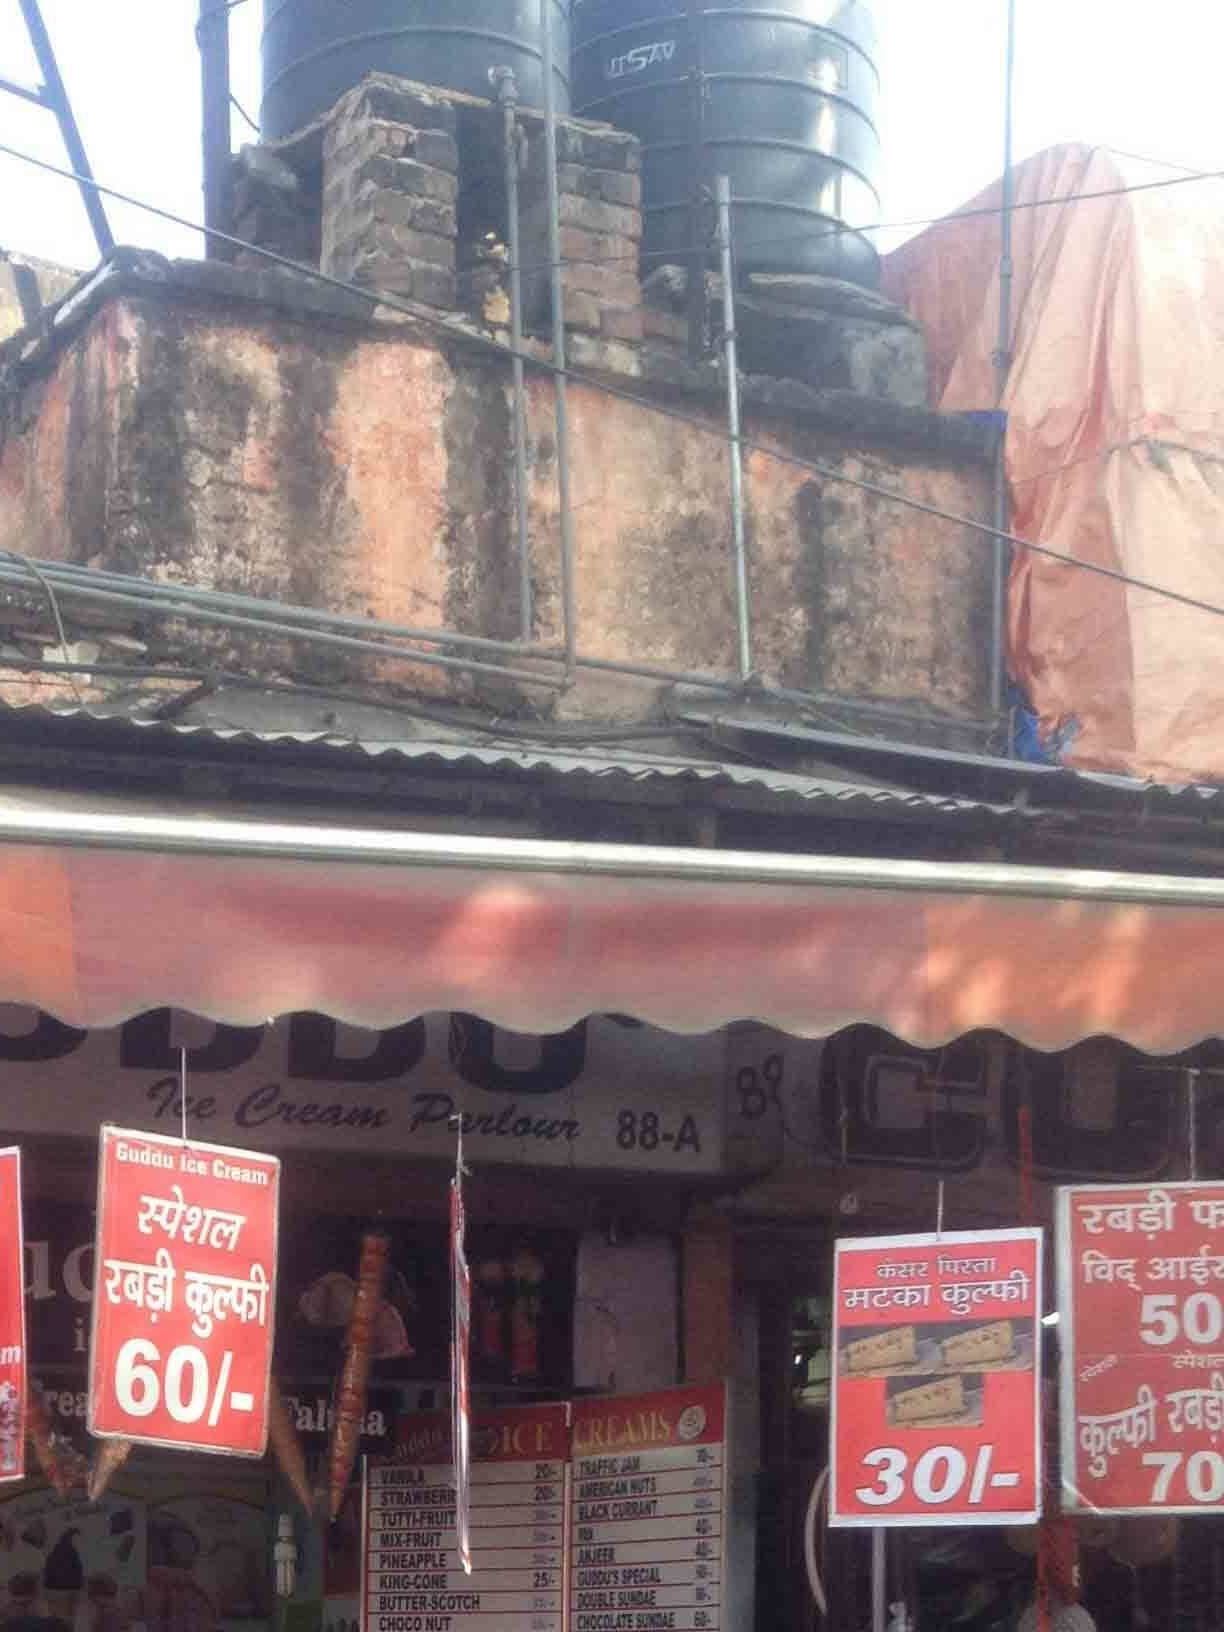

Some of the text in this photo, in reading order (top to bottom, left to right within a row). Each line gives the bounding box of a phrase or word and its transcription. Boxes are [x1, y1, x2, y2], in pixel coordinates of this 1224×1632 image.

[235, 1084, 390, 1129] Cream
[410, 1093, 580, 1143] Parlour
[615, 1108, 701, 1154] 88-A
[115, 1141, 268, 1186] Guddu Ice Cream
[137, 1185, 247, 1252] स्पेशल
[1077, 1190, 1176, 1240] रबड़ी
[104, 1247, 176, 1324] रबड़ी
[183, 1264, 270, 1338] कुल्फी
[843, 1270, 1031, 1315] मटका कुल्फी
[1140, 1292, 1222, 1345] 50
[114, 1337, 254, 1427] 60/-
[1078, 1384, 1157, 1478] कुल्फी
[856, 1444, 1020, 1505] 30/-
[1142, 1451, 1224, 1503] 70
[379, 1553, 447, 1568] PINEAPPLE
[380, 1532, 442, 1548] MIX-FRUIT
[378, 1595, 480, 1611] BUTTER-SCOTCH
[379, 1574, 448, 1589] KING-CONE
[378, 1616, 452, 1631] CHOCO NUT
[577, 1614, 633, 1630] CHOCOLATE
